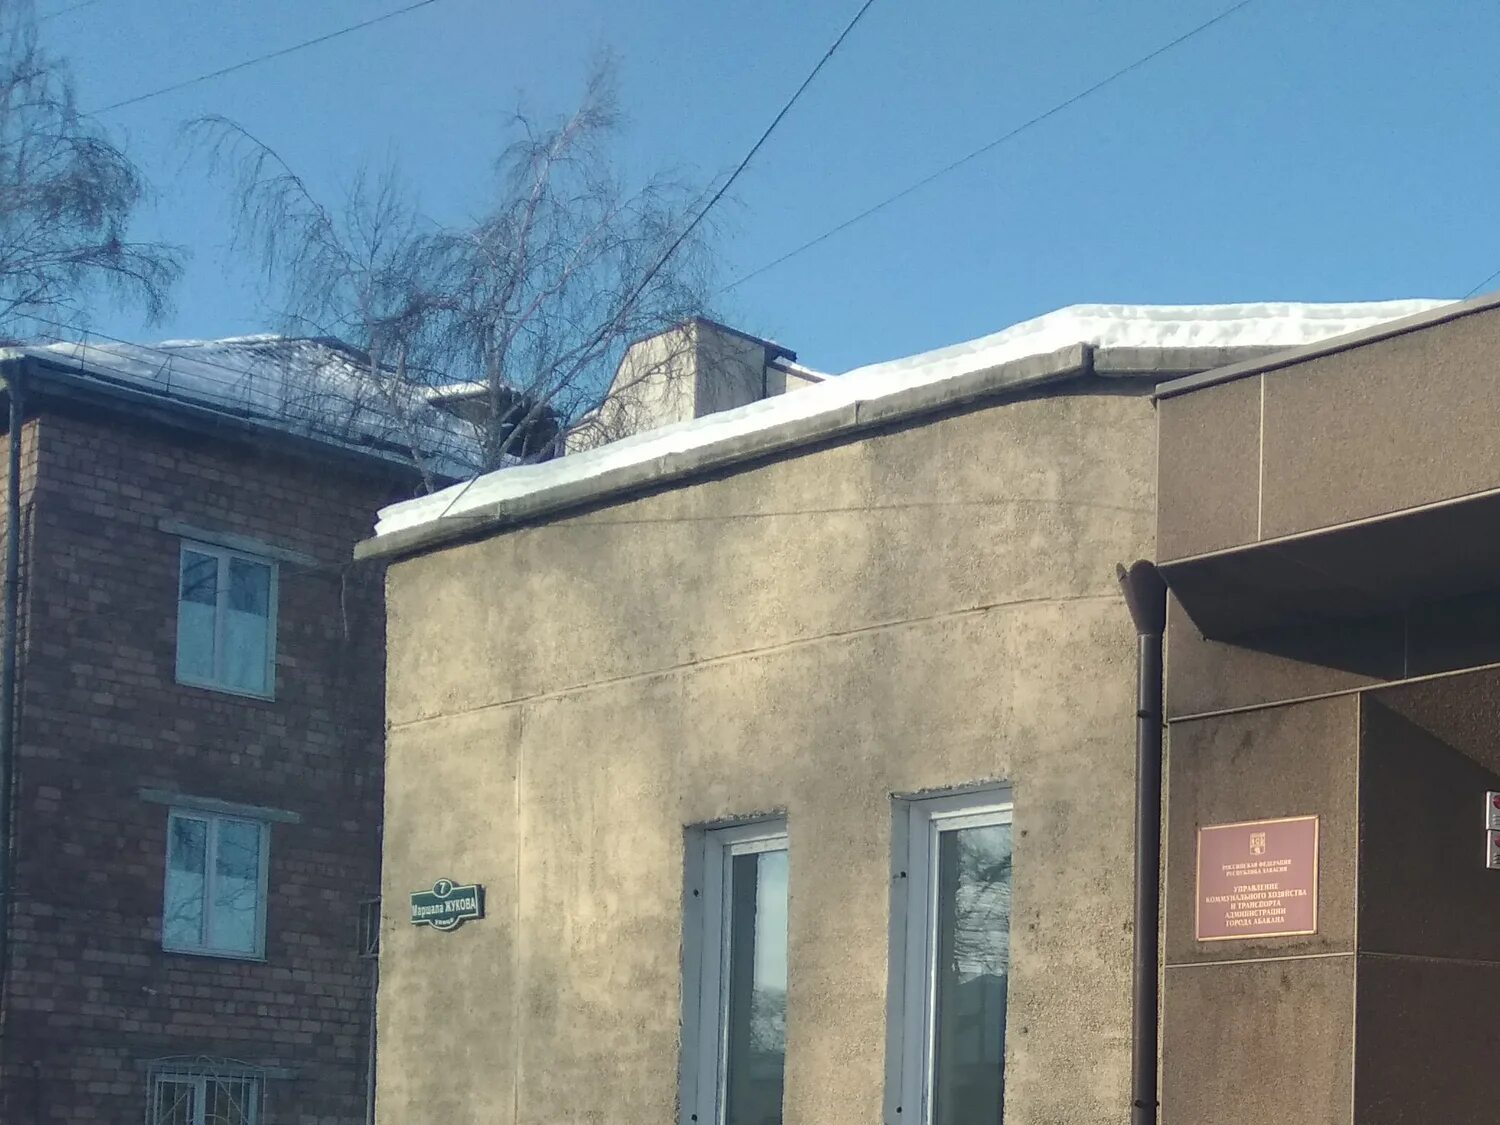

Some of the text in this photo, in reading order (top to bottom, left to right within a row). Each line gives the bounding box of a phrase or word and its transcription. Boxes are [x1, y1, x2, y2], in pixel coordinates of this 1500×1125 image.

[439, 882, 446, 894] 7
[1233, 883, 1280, 893] УПРАВЛЕНИЕ
[445, 897, 476, 912] ЖУКОВА
[1238, 900, 1281, 909] ТРАНСПОРТА
[1224, 907, 1287, 919] АДМИНИСТРАЦИИ
[1226, 916, 1285, 927] ГОРОДА АБАКАНА
